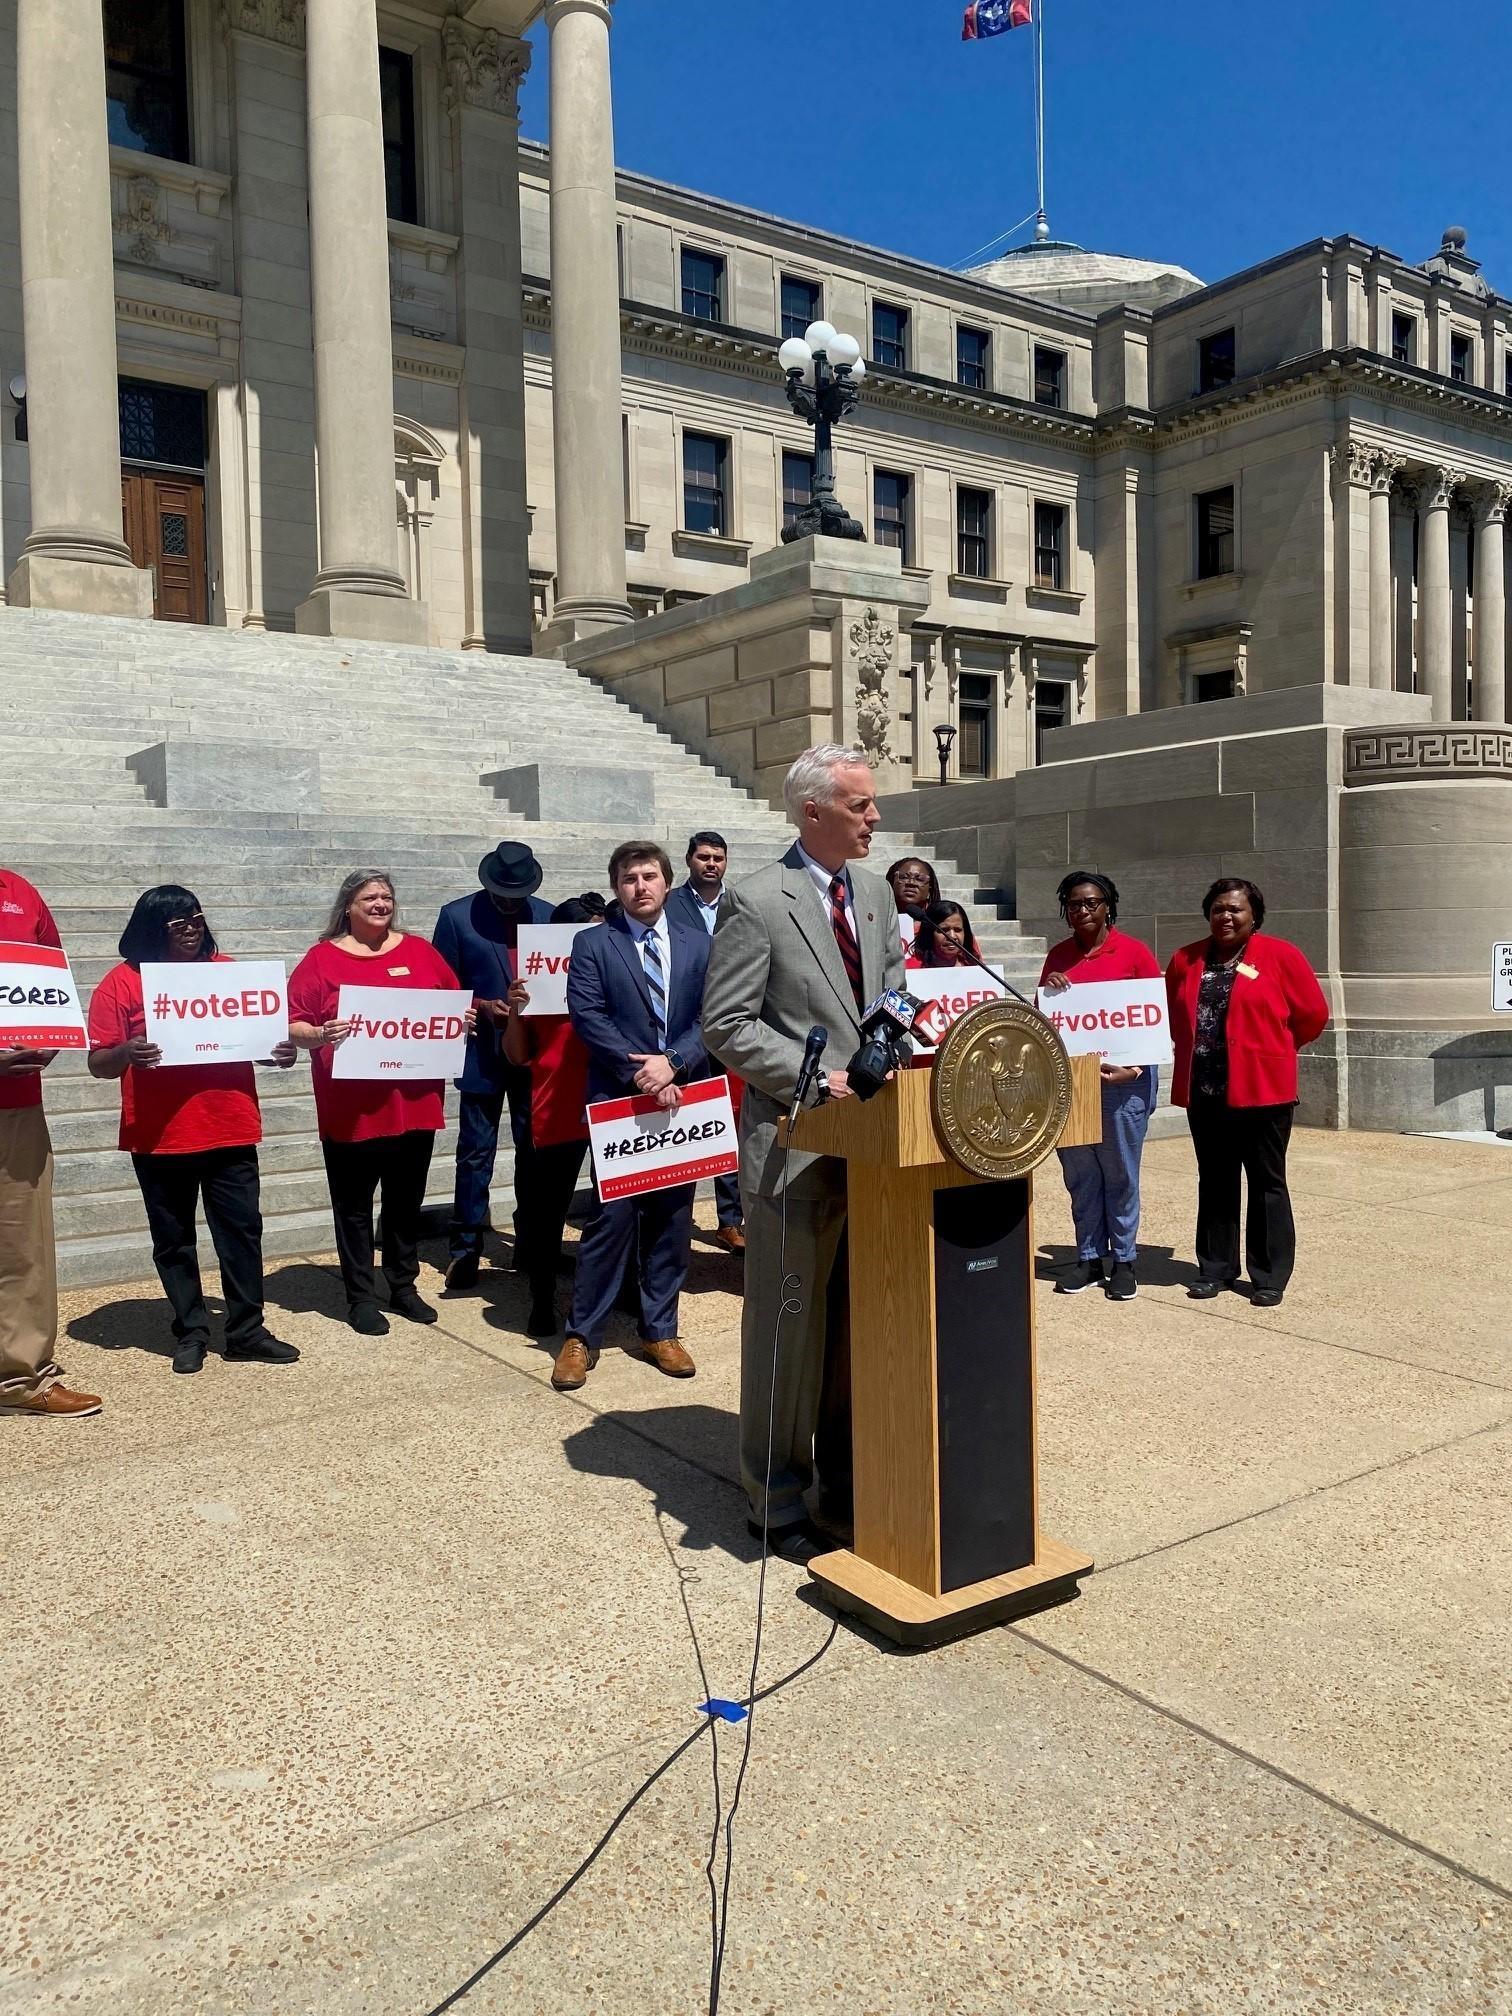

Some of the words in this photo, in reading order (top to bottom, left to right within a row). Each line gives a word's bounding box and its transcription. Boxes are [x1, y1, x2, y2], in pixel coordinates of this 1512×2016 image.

[152, 989, 281, 1019] #voteED
[884, 1003, 911, 1026] NEWS
[1050, 1003, 1162, 1033] #voteED
[0, 1034, 44, 1042] UCATORS
[346, 1013, 464, 1040] #voteED
[603, 1119, 727, 1160] #REDFORED
[605, 1177, 655, 1193] MISSISSIPPI
[657, 1166, 703, 1182] EDUCATORS
[704, 1159, 732, 1171] UNITED
